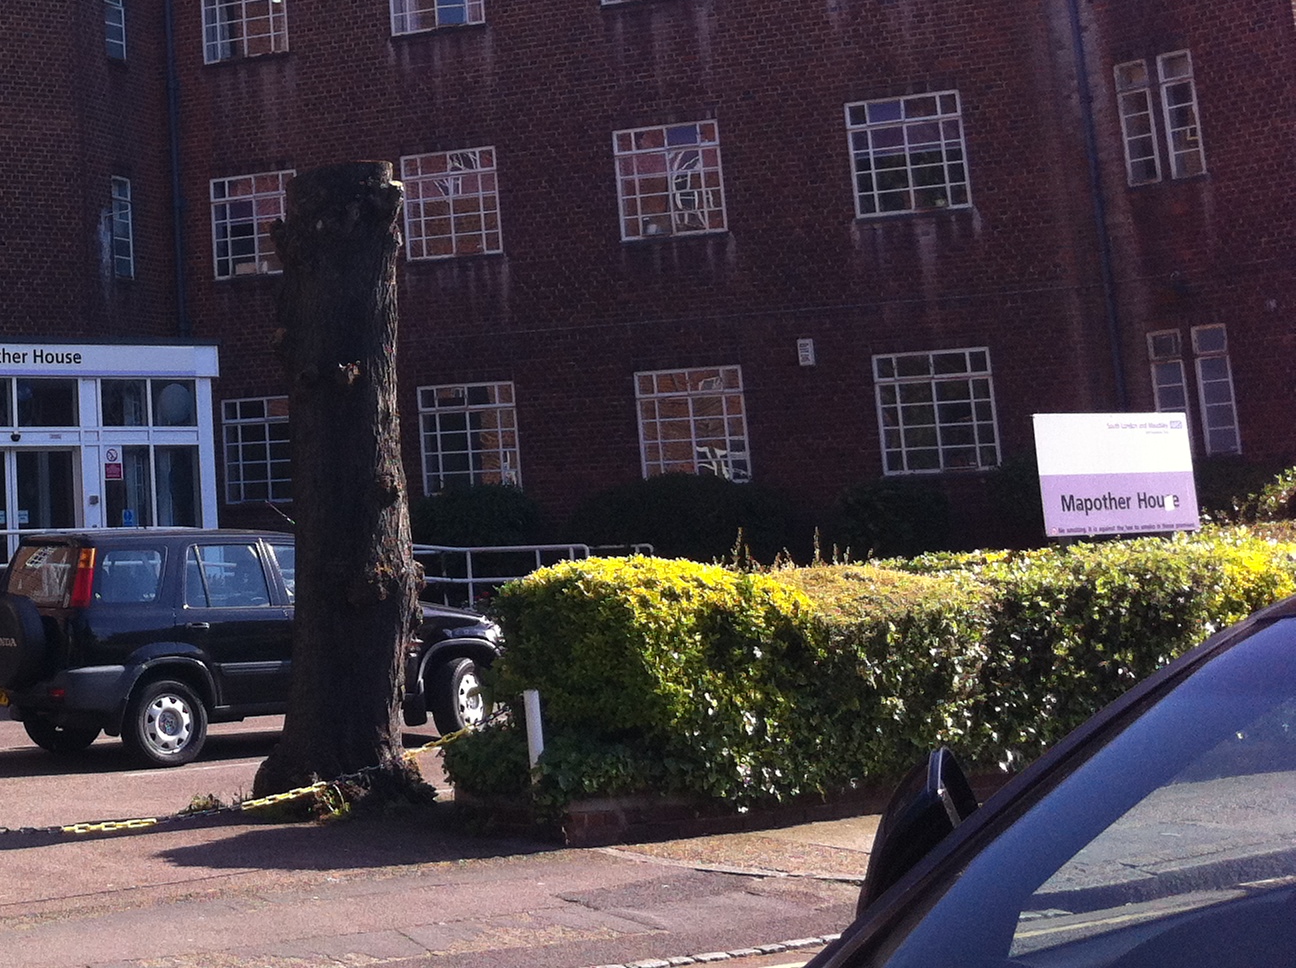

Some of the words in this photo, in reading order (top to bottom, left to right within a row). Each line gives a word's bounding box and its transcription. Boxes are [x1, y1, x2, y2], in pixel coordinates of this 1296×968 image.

[32, 349, 82, 364] House
[1060, 492, 1131, 516] Mapother
[1137, 492, 1180, 510] Houe
